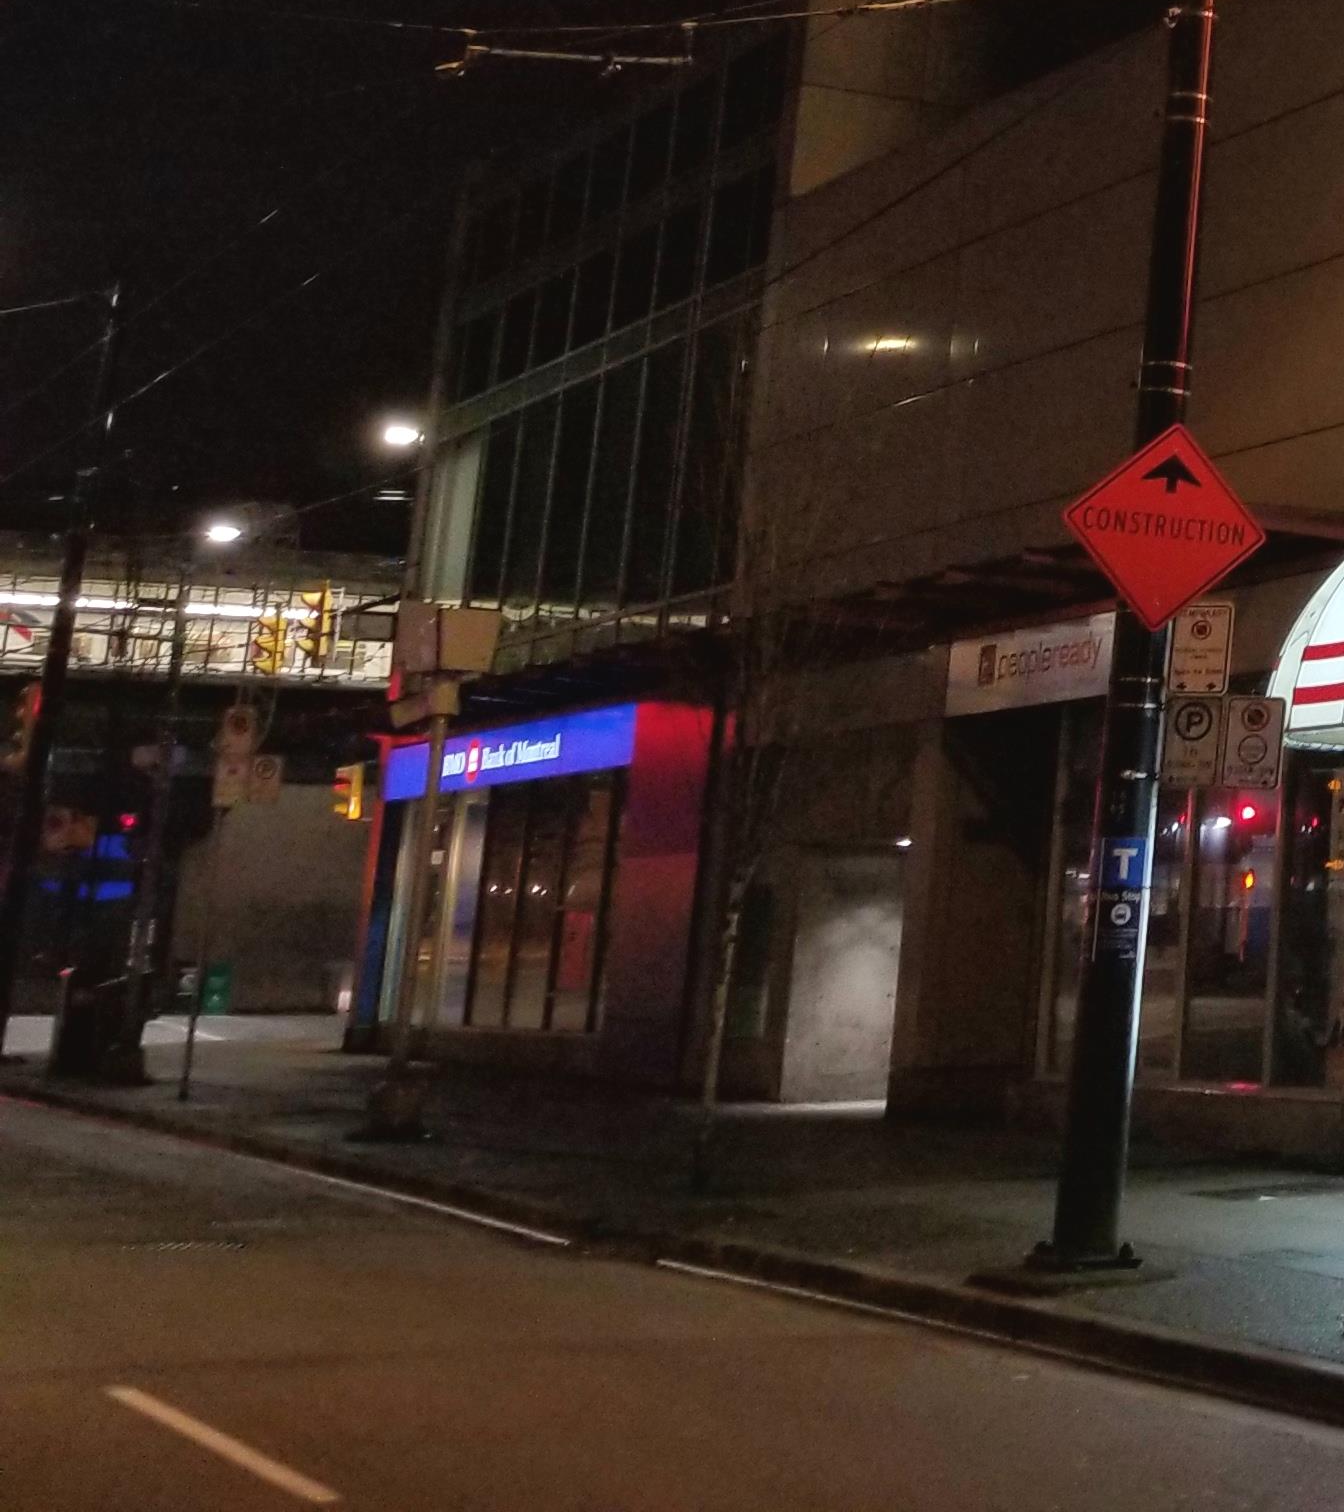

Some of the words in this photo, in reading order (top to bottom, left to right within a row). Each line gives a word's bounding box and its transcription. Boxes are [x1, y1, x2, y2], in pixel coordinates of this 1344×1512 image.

[1083, 506, 1246, 547] CONSTRUCTION
[480, 744, 505, 770] Bank
[514, 733, 561, 764] Montreal
